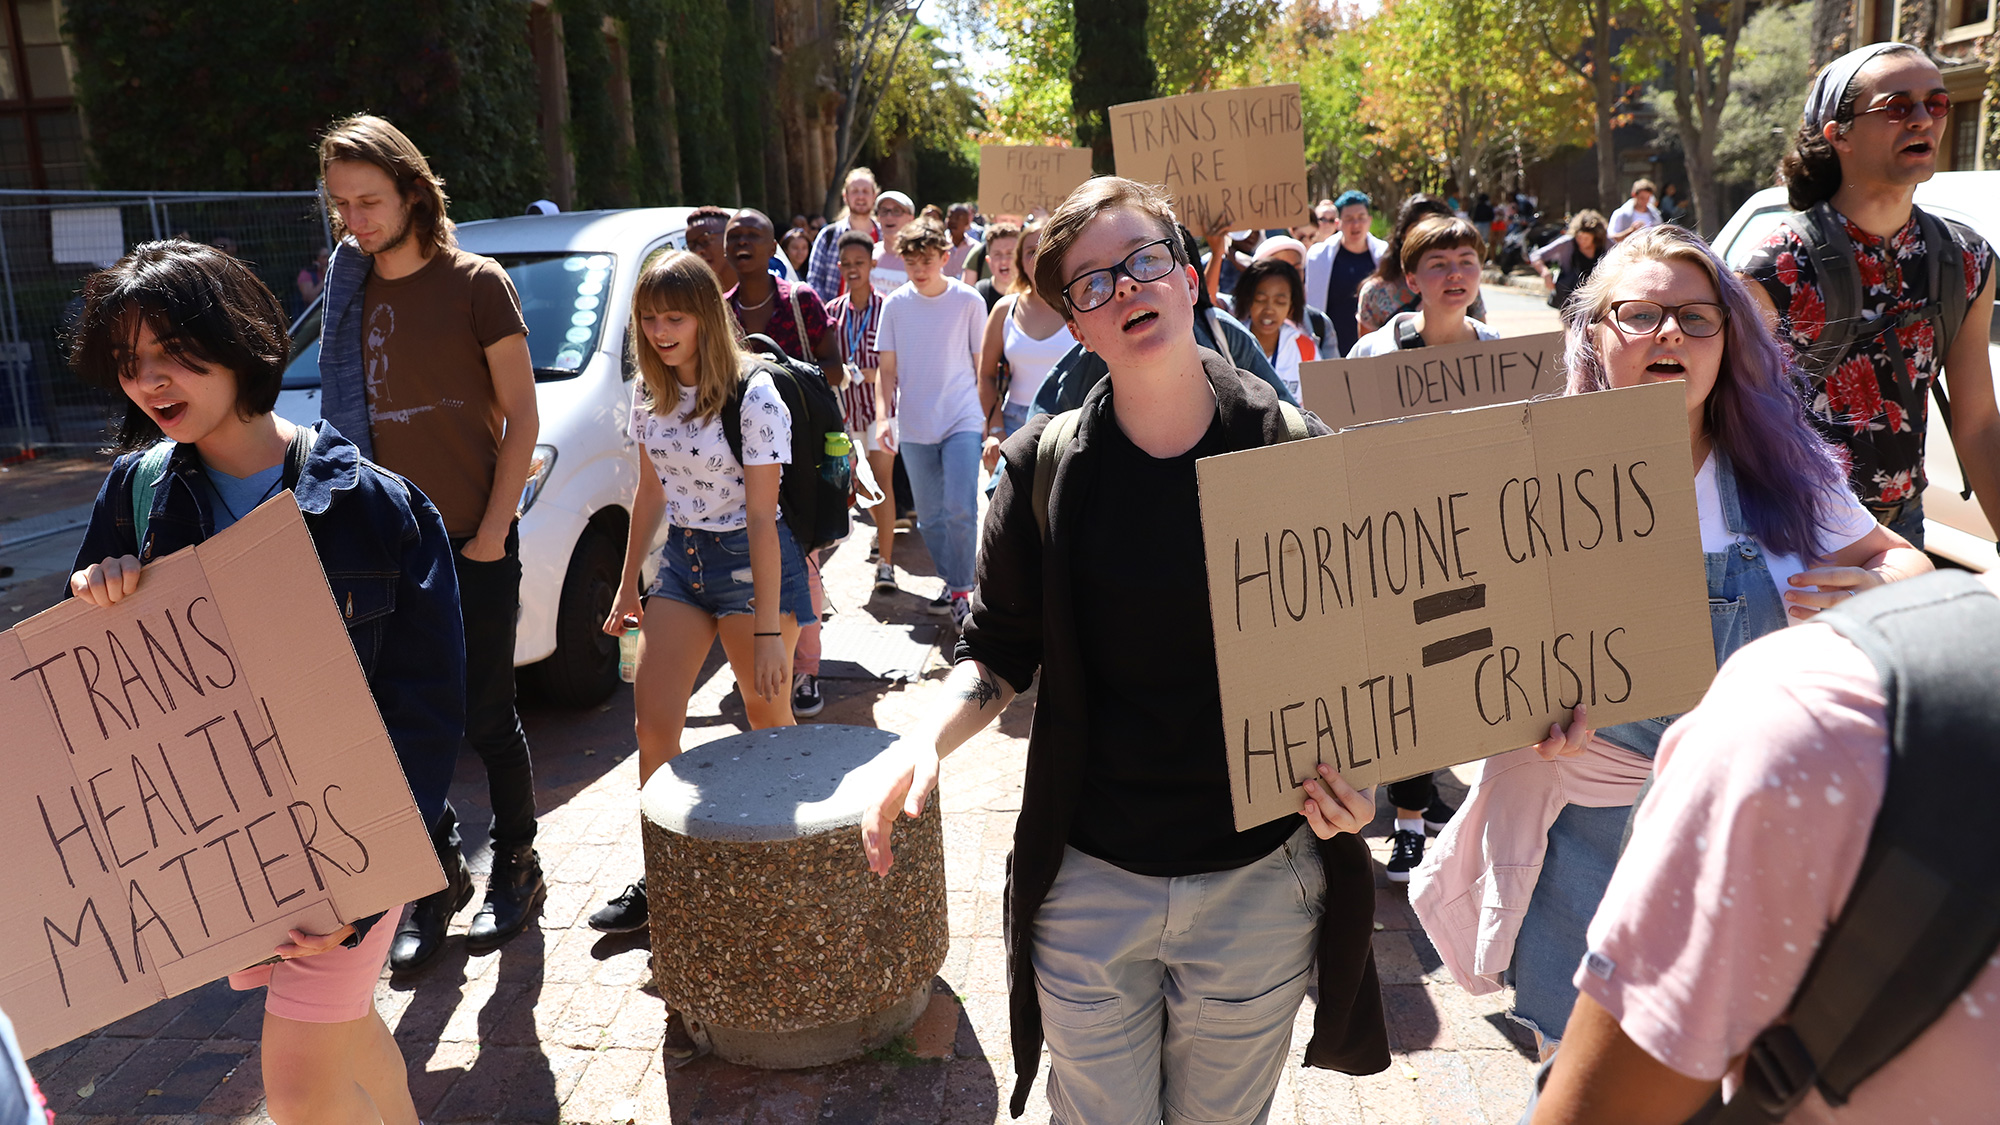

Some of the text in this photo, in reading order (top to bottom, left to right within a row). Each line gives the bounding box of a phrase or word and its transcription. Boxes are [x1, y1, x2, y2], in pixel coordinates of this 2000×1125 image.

[1119, 92, 1302, 153] TRANS RIGHTS
[1006, 149, 1066, 174] FIGHT
[1018, 173, 1047, 194] THE
[1163, 148, 1226, 188] ARE
[1171, 181, 1304, 227] MAN RIGHTS
[1343, 350, 1544, 416] I IDENTIFY
[1233, 460, 1656, 633] HORMONE CRISIS
[9, 596, 237, 756] TRANS
[1243, 626, 1632, 805] HEALTH CRISIS
[36, 697, 298, 889] HEALTH
[42, 783, 371, 1009] MATTERS
